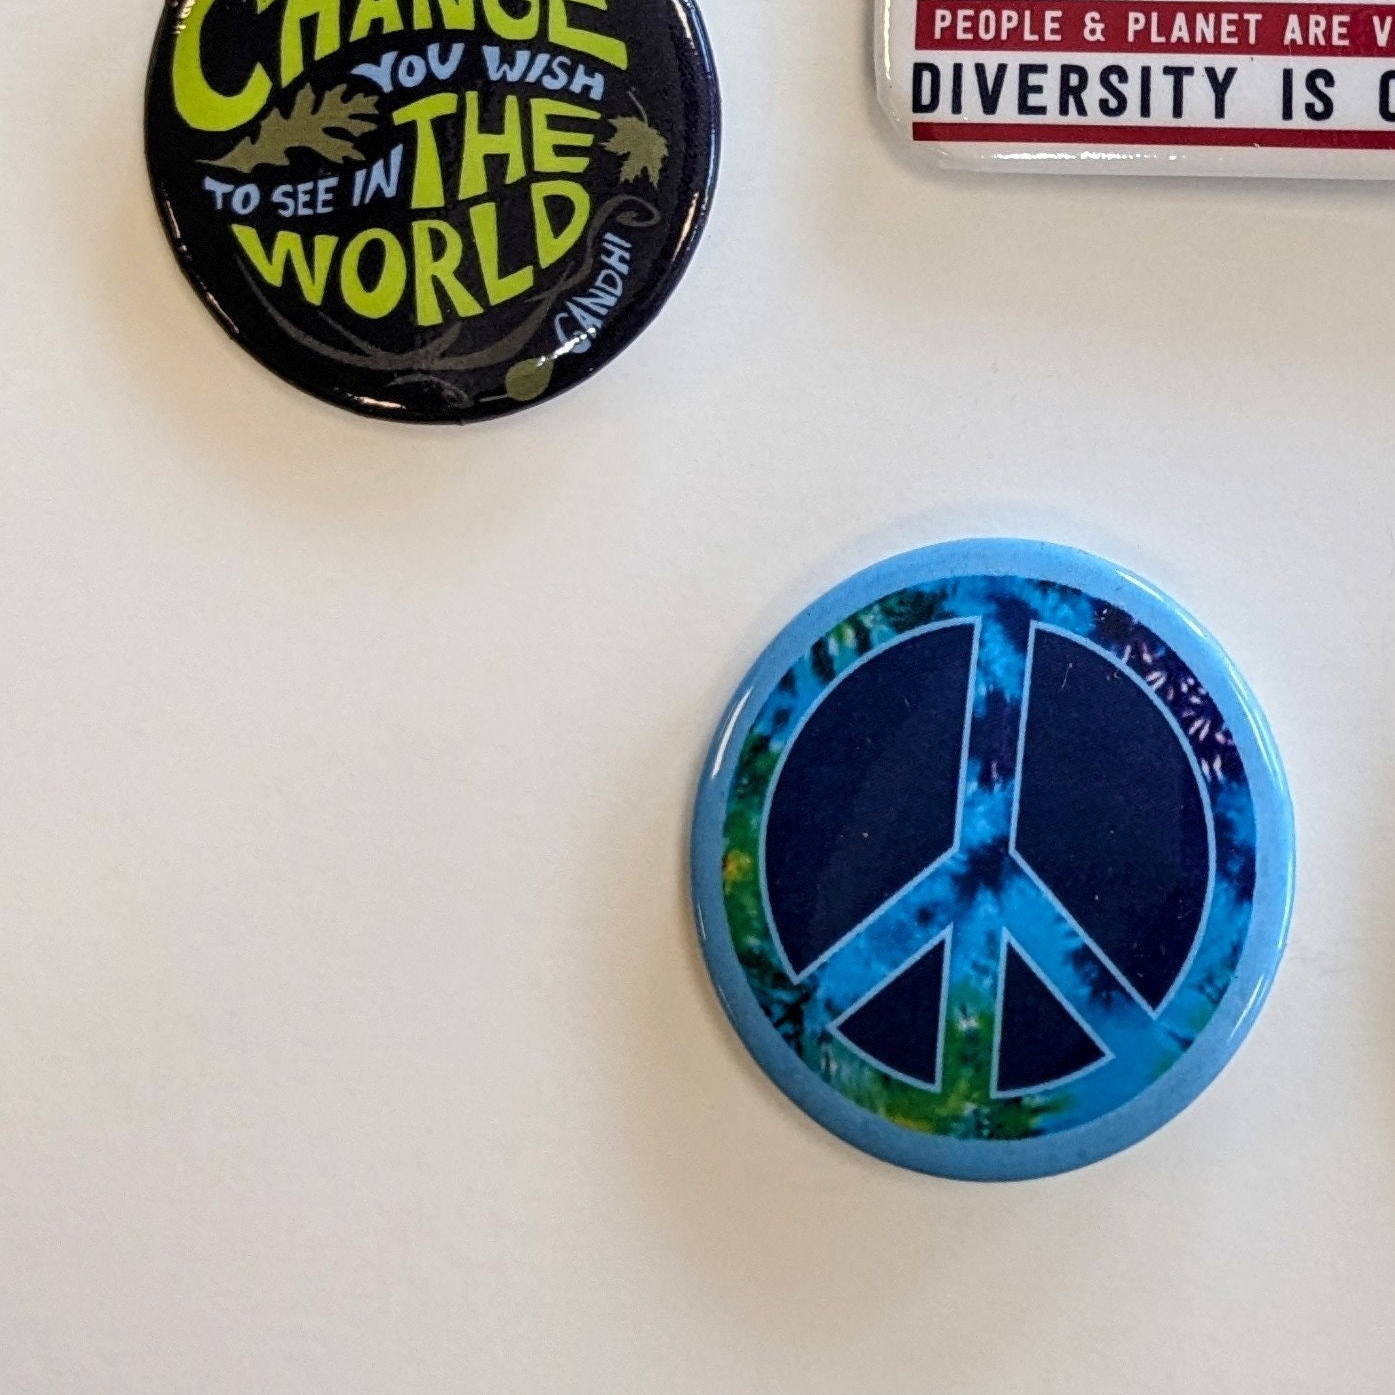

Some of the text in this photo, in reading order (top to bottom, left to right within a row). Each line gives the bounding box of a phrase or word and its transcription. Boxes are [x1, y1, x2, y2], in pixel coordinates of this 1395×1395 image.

[933, 8, 1062, 42] PEOPLE
[1083, 10, 1106, 42] &
[1127, 11, 1262, 45] PLANET
[1283, 13, 1351, 46] ARE
[351, 42, 606, 101] YOU WISH
[911, 61, 1237, 119] DIVERSITY
[1281, 68, 1335, 122] IS
[204, 144, 404, 217] TO SEE IN
[393, 90, 601, 209] THE
[231, 180, 590, 326] WORLD
[554, 231, 633, 354] GANDHI
